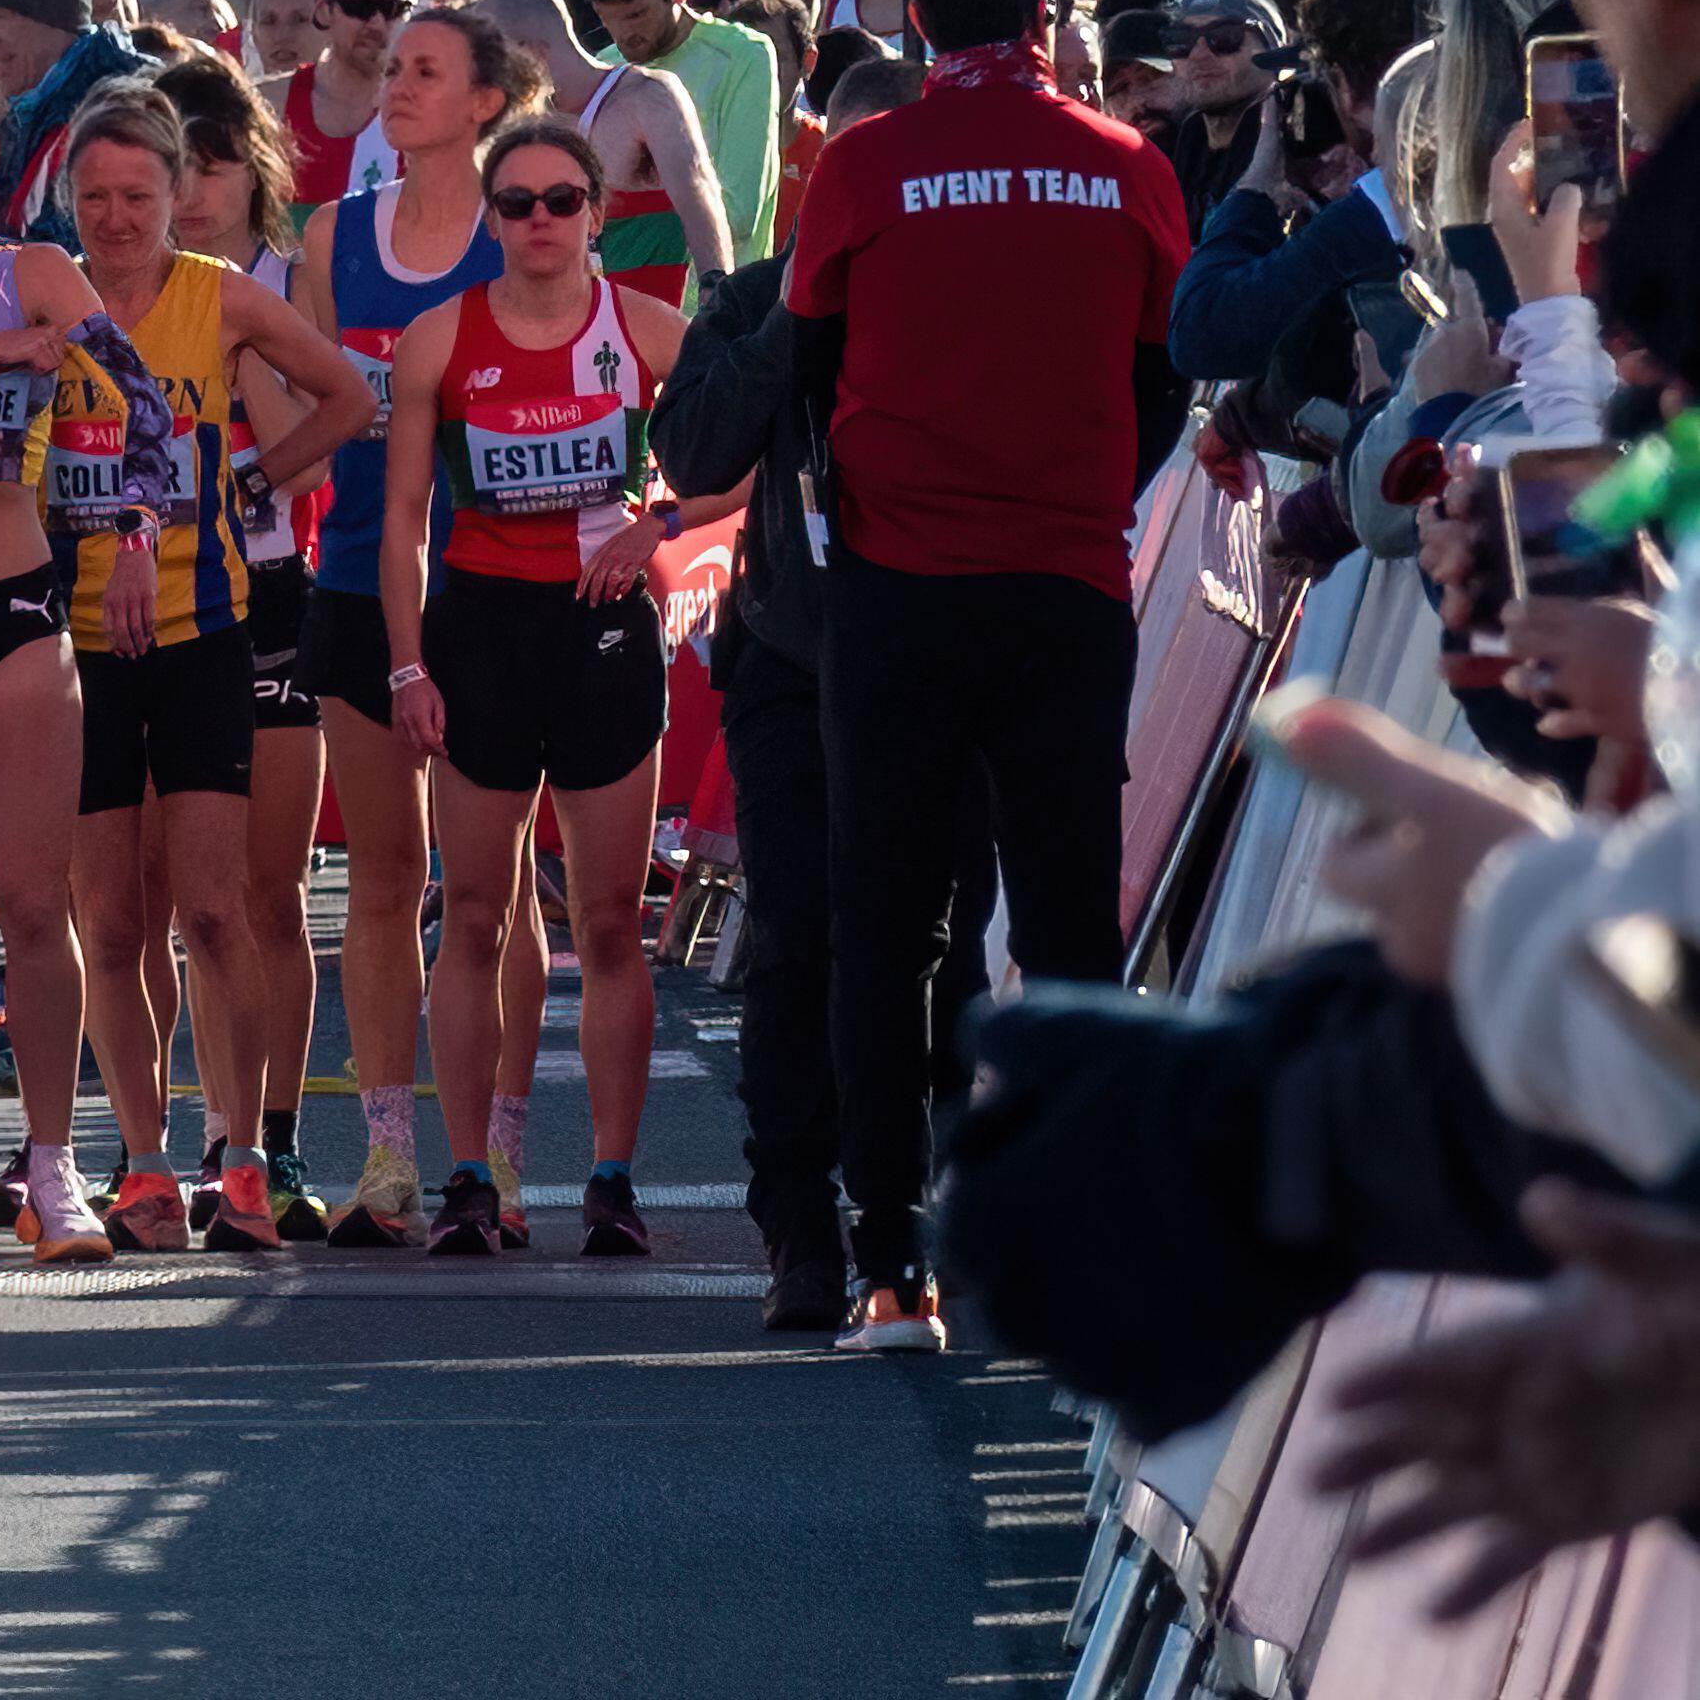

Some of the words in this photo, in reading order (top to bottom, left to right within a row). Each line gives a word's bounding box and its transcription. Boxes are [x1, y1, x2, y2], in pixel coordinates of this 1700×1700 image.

[902, 168, 1013, 213] EVENT
[1023, 167, 1122, 210] TEAM
[483, 436, 617, 483] ESTLEA
